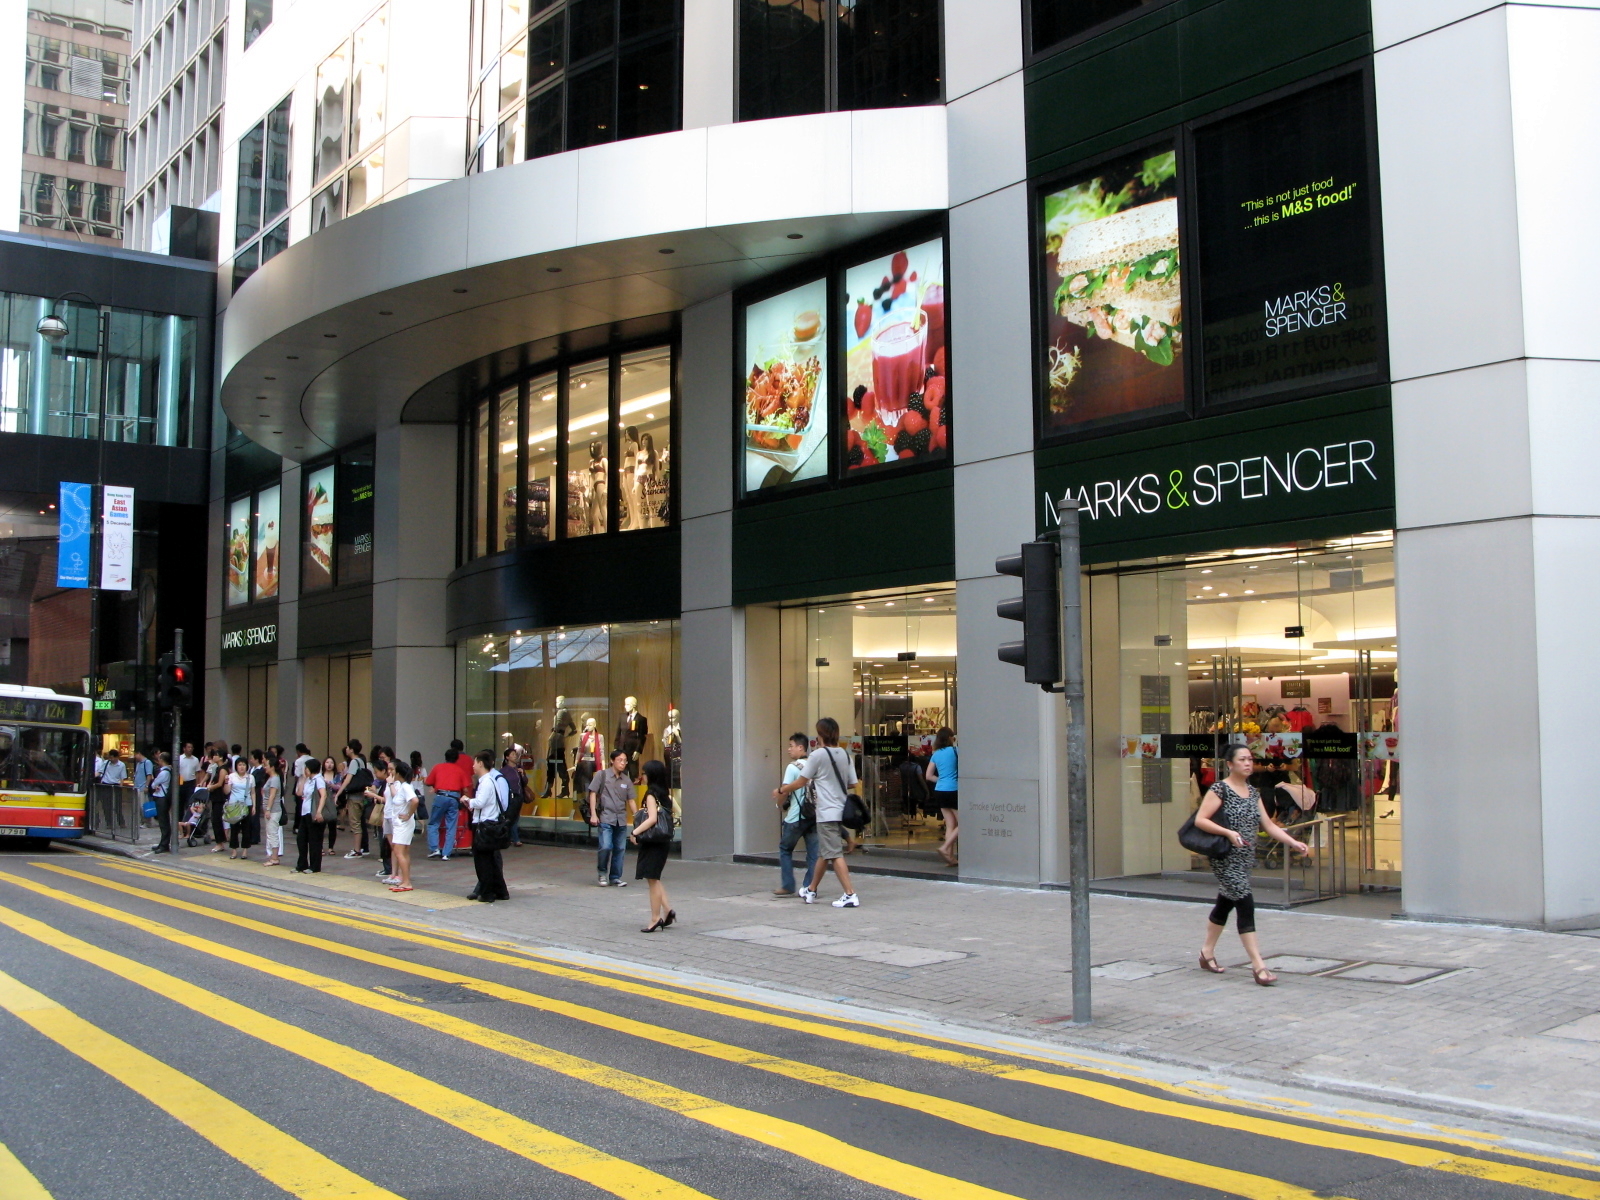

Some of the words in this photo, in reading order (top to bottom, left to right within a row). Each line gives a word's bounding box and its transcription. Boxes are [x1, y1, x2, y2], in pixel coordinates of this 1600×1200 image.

[1266, 196, 1274, 206] is
[1275, 190, 1291, 203] not
[1292, 184, 1310, 200] just
[1312, 176, 1334, 192] food
[1254, 215, 1270, 227] this
[1271, 211, 1280, 222] is
[1281, 197, 1313, 219] M&S
[1265, 301, 1347, 338] SPENCER
[1192, 439, 1377, 506] SPENCER
[247, 624, 277, 646] SPENCER
[45, 703, 66, 719] 12M
[1175, 743, 1191, 751] Food
[1198, 743, 1209, 751] Go
[969, 801, 989, 811] Smoke
[990, 802, 1006, 812] Vent
[1006, 802, 1027, 813] Outlet
